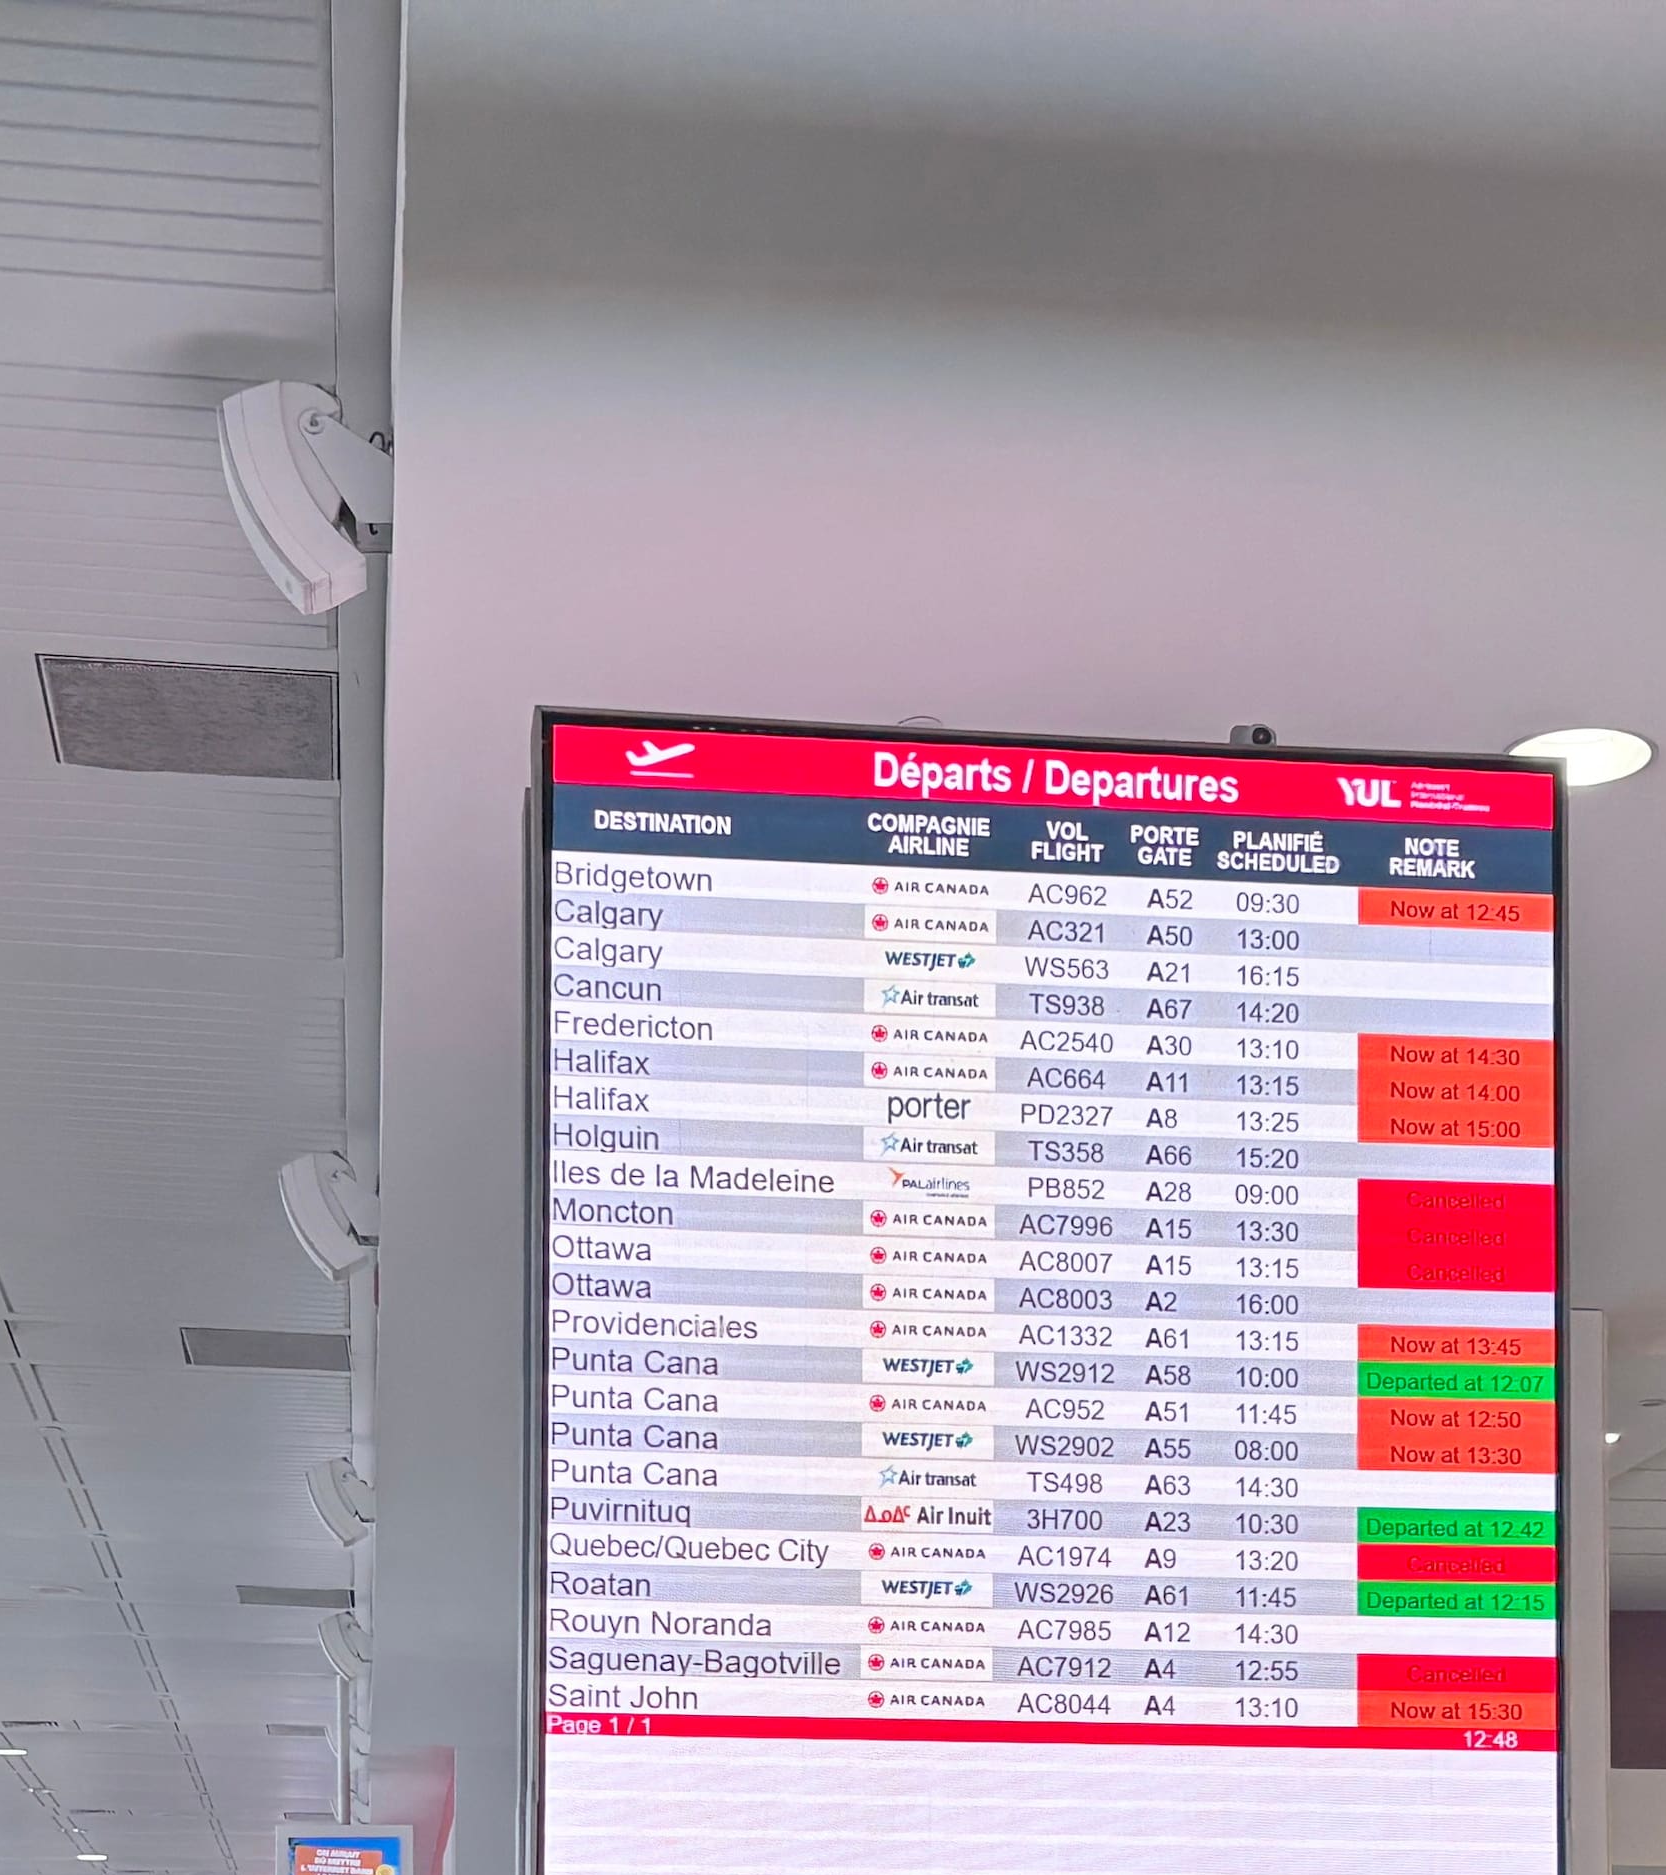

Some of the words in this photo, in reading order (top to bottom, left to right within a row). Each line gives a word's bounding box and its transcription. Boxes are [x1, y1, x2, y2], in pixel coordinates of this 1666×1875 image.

[873, 751, 1012, 794] Départs
[1022, 758, 1033, 796] /
[1045, 759, 1239, 805] Departures
[1337, 775, 1400, 808] YUL
[594, 811, 731, 835] DESTINATION
[867, 814, 991, 837] COMPAGNIE
[1046, 822, 1089, 842] VOL
[1131, 825, 1199, 847] PORTE
[887, 836, 969, 857] AIRLINE
[1031, 842, 1103, 863] FLIGHT
[1233, 828, 1323, 852] PLANIFIÉ
[1404, 838, 1460, 859] NOTE
[1138, 847, 1192, 867] GATE
[1217, 852, 1340, 875] SCHEDULED
[1389, 858, 1475, 879] REMARK
[554, 863, 712, 893] Bridgetown
[1027, 882, 1108, 907] AC962
[554, 899, 663, 931] Calgary
[554, 936, 663, 969] Calgary
[1024, 955, 1110, 980] WS563
[553, 974, 661, 1001] Cancun
[553, 1011, 712, 1040] Fredericton
[1019, 1029, 1114, 1054] AC2540
[553, 1048, 650, 1075] Halifax
[553, 1086, 649, 1112] Halifax
[1020, 1102, 1114, 1127] PD2327
[553, 1123, 659, 1153] Holguin
[552, 1161, 600, 1184] Iles
[611, 1163, 645, 1186] de
[656, 1164, 678, 1187] la
[691, 1165, 834, 1193] Madeleine
[1028, 1176, 1105, 1200] PB852
[552, 1198, 673, 1225] Moncton
[552, 1235, 651, 1261] Ottawa
[1018, 1250, 1114, 1274] AC8007
[552, 1272, 651, 1298] Ottawa
[552, 1310, 758, 1339] Providenciales
[1018, 1323, 1113, 1348] AC1332
[551, 1347, 632, 1372] Punta
[644, 1350, 718, 1375] Cana
[551, 1385, 632, 1409] Punta
[644, 1387, 718, 1412] Cana
[1024, 1397, 1105, 1421] AC952
[551, 1422, 632, 1447] Punta
[644, 1424, 718, 1450] Cana
[551, 1459, 631, 1484] Punta
[643, 1462, 717, 1486] Cana
[1026, 1471, 1104, 1494] TS498
[551, 1497, 690, 1528] Puvirnituq
[550, 1533, 770, 1561] Quebec/Quebec
[778, 1539, 829, 1569] City
[1017, 1544, 1113, 1568] AC1974
[550, 1571, 650, 1597] Roatan
[550, 1609, 639, 1639] Rouyn
[652, 1611, 771, 1636] Noranda
[1016, 1618, 1112, 1642] AC7985
[550, 1646, 840, 1678] Saguenay-Bagotville
[550, 1684, 620, 1707] Saint
[630, 1685, 697, 1709] John
[1016, 1692, 1112, 1715] AC8044
[546, 1715, 601, 1737] Page
[610, 1717, 618, 1734] 1
[625, 1717, 634, 1735] /
[642, 1718, 651, 1735] 1
[1464, 1731, 1518, 1748] 12:48
